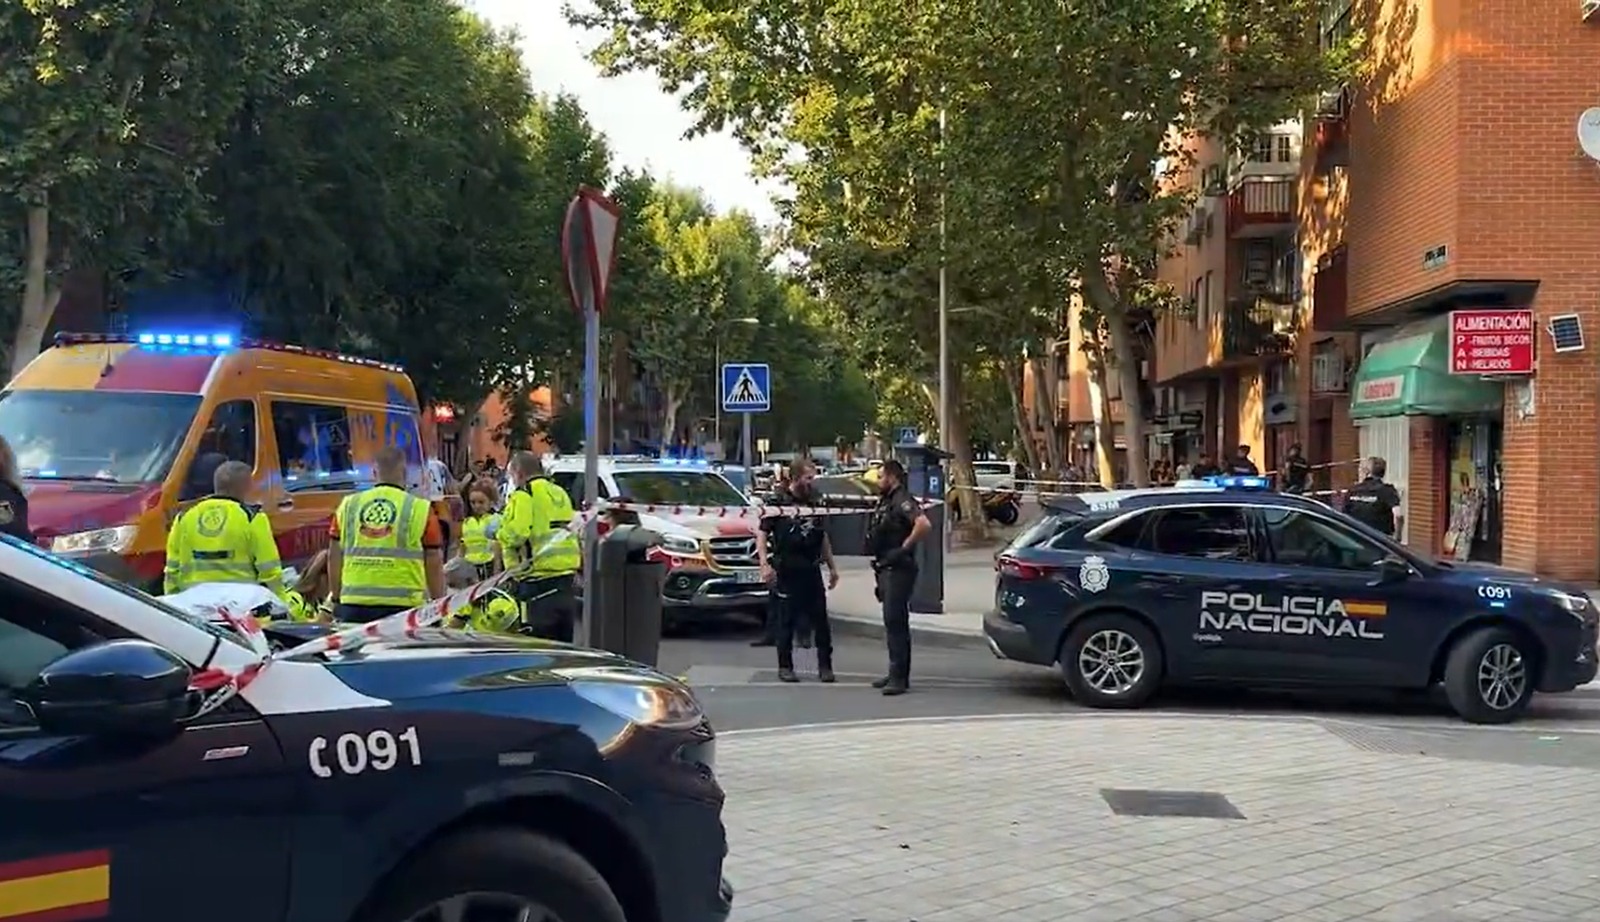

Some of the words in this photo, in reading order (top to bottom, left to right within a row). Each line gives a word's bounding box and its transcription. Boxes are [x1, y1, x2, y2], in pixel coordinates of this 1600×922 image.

[1456, 312, 1530, 331] ALIMENTACIÓN
[1457, 335, 1466, 345] P
[1504, 335, 1531, 345] SECOS
[1457, 348, 1467, 358] A
[1457, 360, 1467, 370] N
[930, 476, 939, 492] P
[1486, 586, 1511, 598] 091
[1201, 591, 1348, 617] POLICIA
[1200, 611, 1384, 639] NACIONAL
[337, 727, 421, 774] 091
